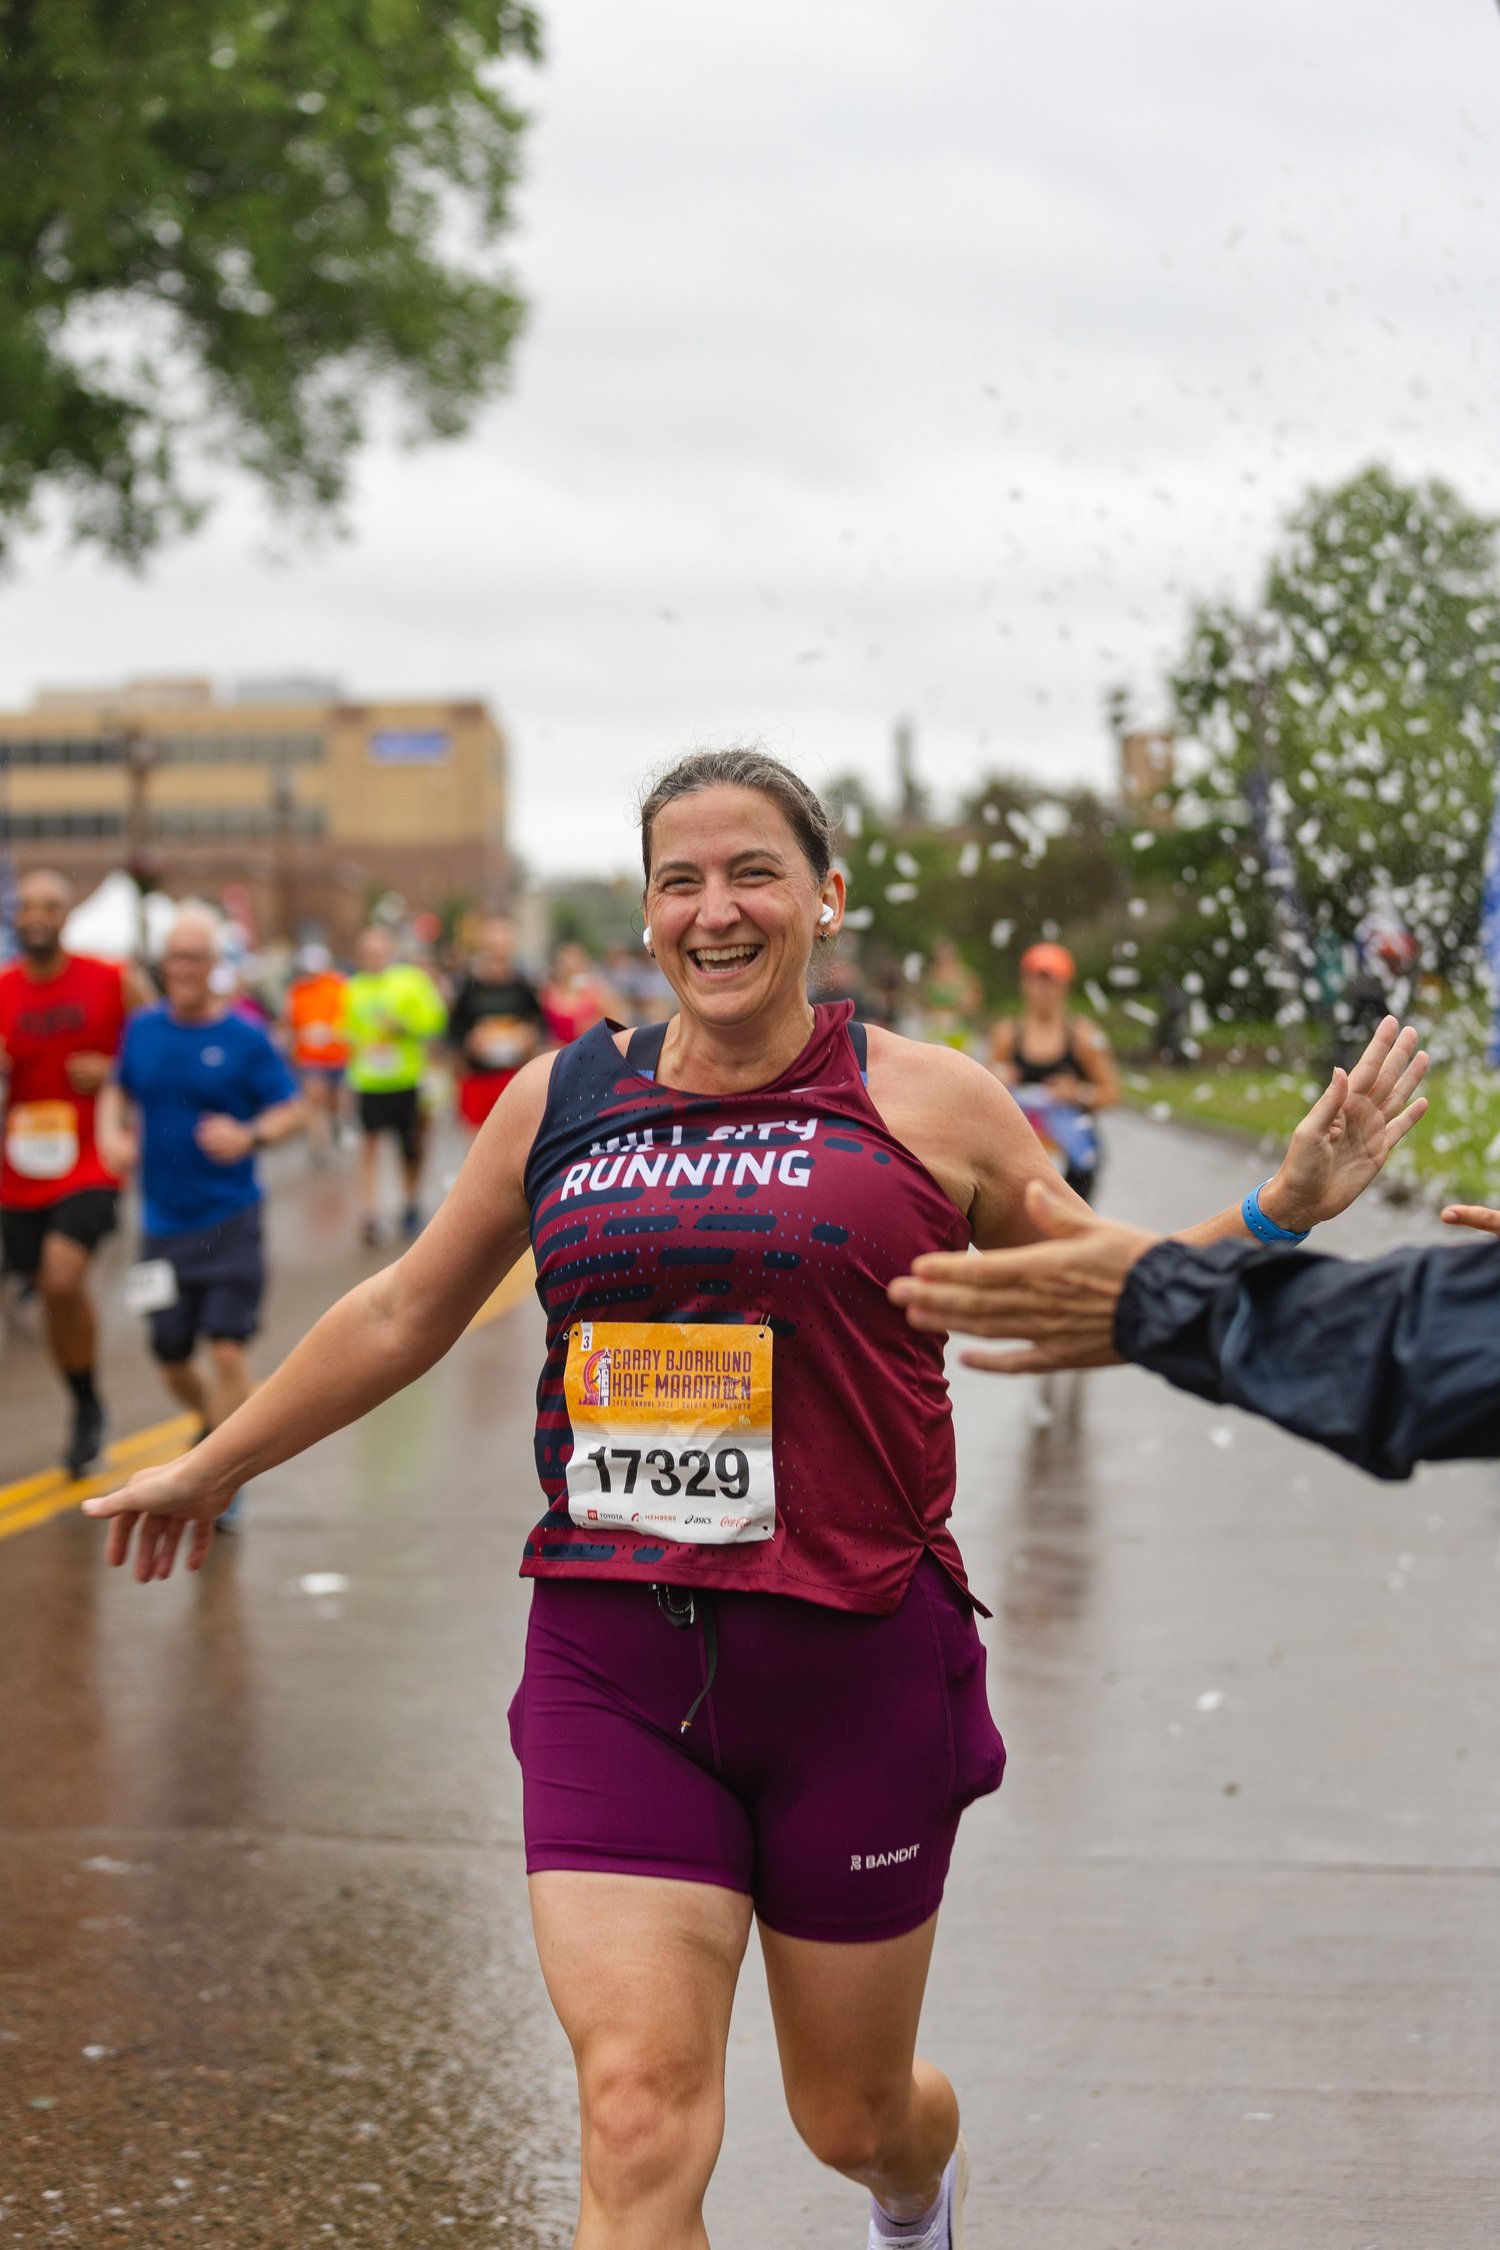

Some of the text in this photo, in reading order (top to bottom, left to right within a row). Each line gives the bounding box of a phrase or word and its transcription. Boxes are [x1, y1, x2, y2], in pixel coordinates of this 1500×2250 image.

[560, 1150, 812, 1202] RUNNING
[583, 1335, 590, 1349] 3
[613, 1349, 752, 1373] GARRY BJORKLUND
[612, 1373, 650, 1398] HALF
[588, 1446, 750, 1499] 17329
[865, 1843, 920, 1869] BANDIT
